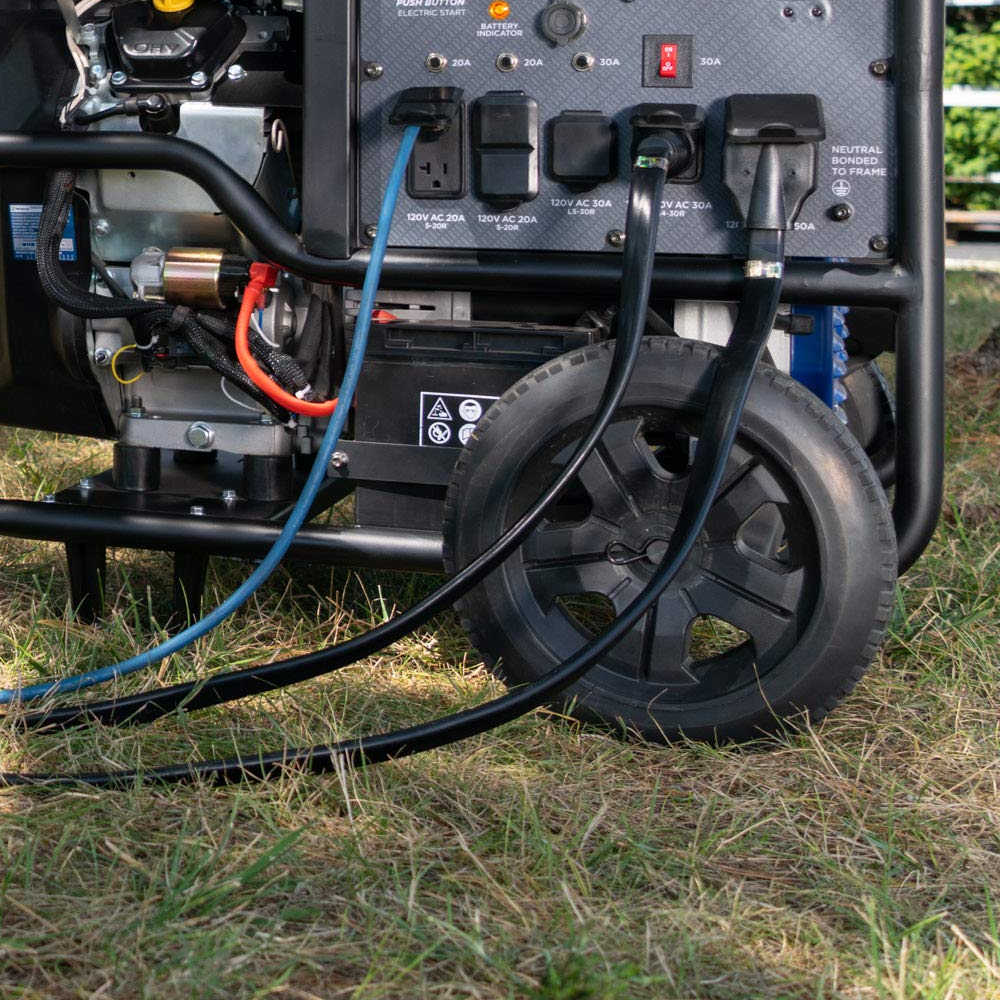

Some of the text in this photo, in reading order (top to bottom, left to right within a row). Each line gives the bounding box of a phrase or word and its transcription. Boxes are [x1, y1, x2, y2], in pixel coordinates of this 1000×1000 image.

[397, 8, 466, 17] ELECTRIC START
[480, 22, 519, 30] BATTERY
[476, 29, 523, 37] INDICATOR
[451, 58, 471, 67] 20A
[523, 58, 544, 67] 20A
[599, 57, 620, 66] 30A
[699, 57, 721, 66] 30A
[831, 145, 883, 154] NEUTRAL
[831, 157, 878, 165] BONDED
[831, 167, 887, 176] TO FRAME
[551, 198, 612, 208] 120V AC 30A
[675, 200, 690, 209] AC
[691, 201, 713, 210] 30A
[406, 213, 466, 222] 120V AC 20A
[477, 214, 538, 224] 120V AC 20A
